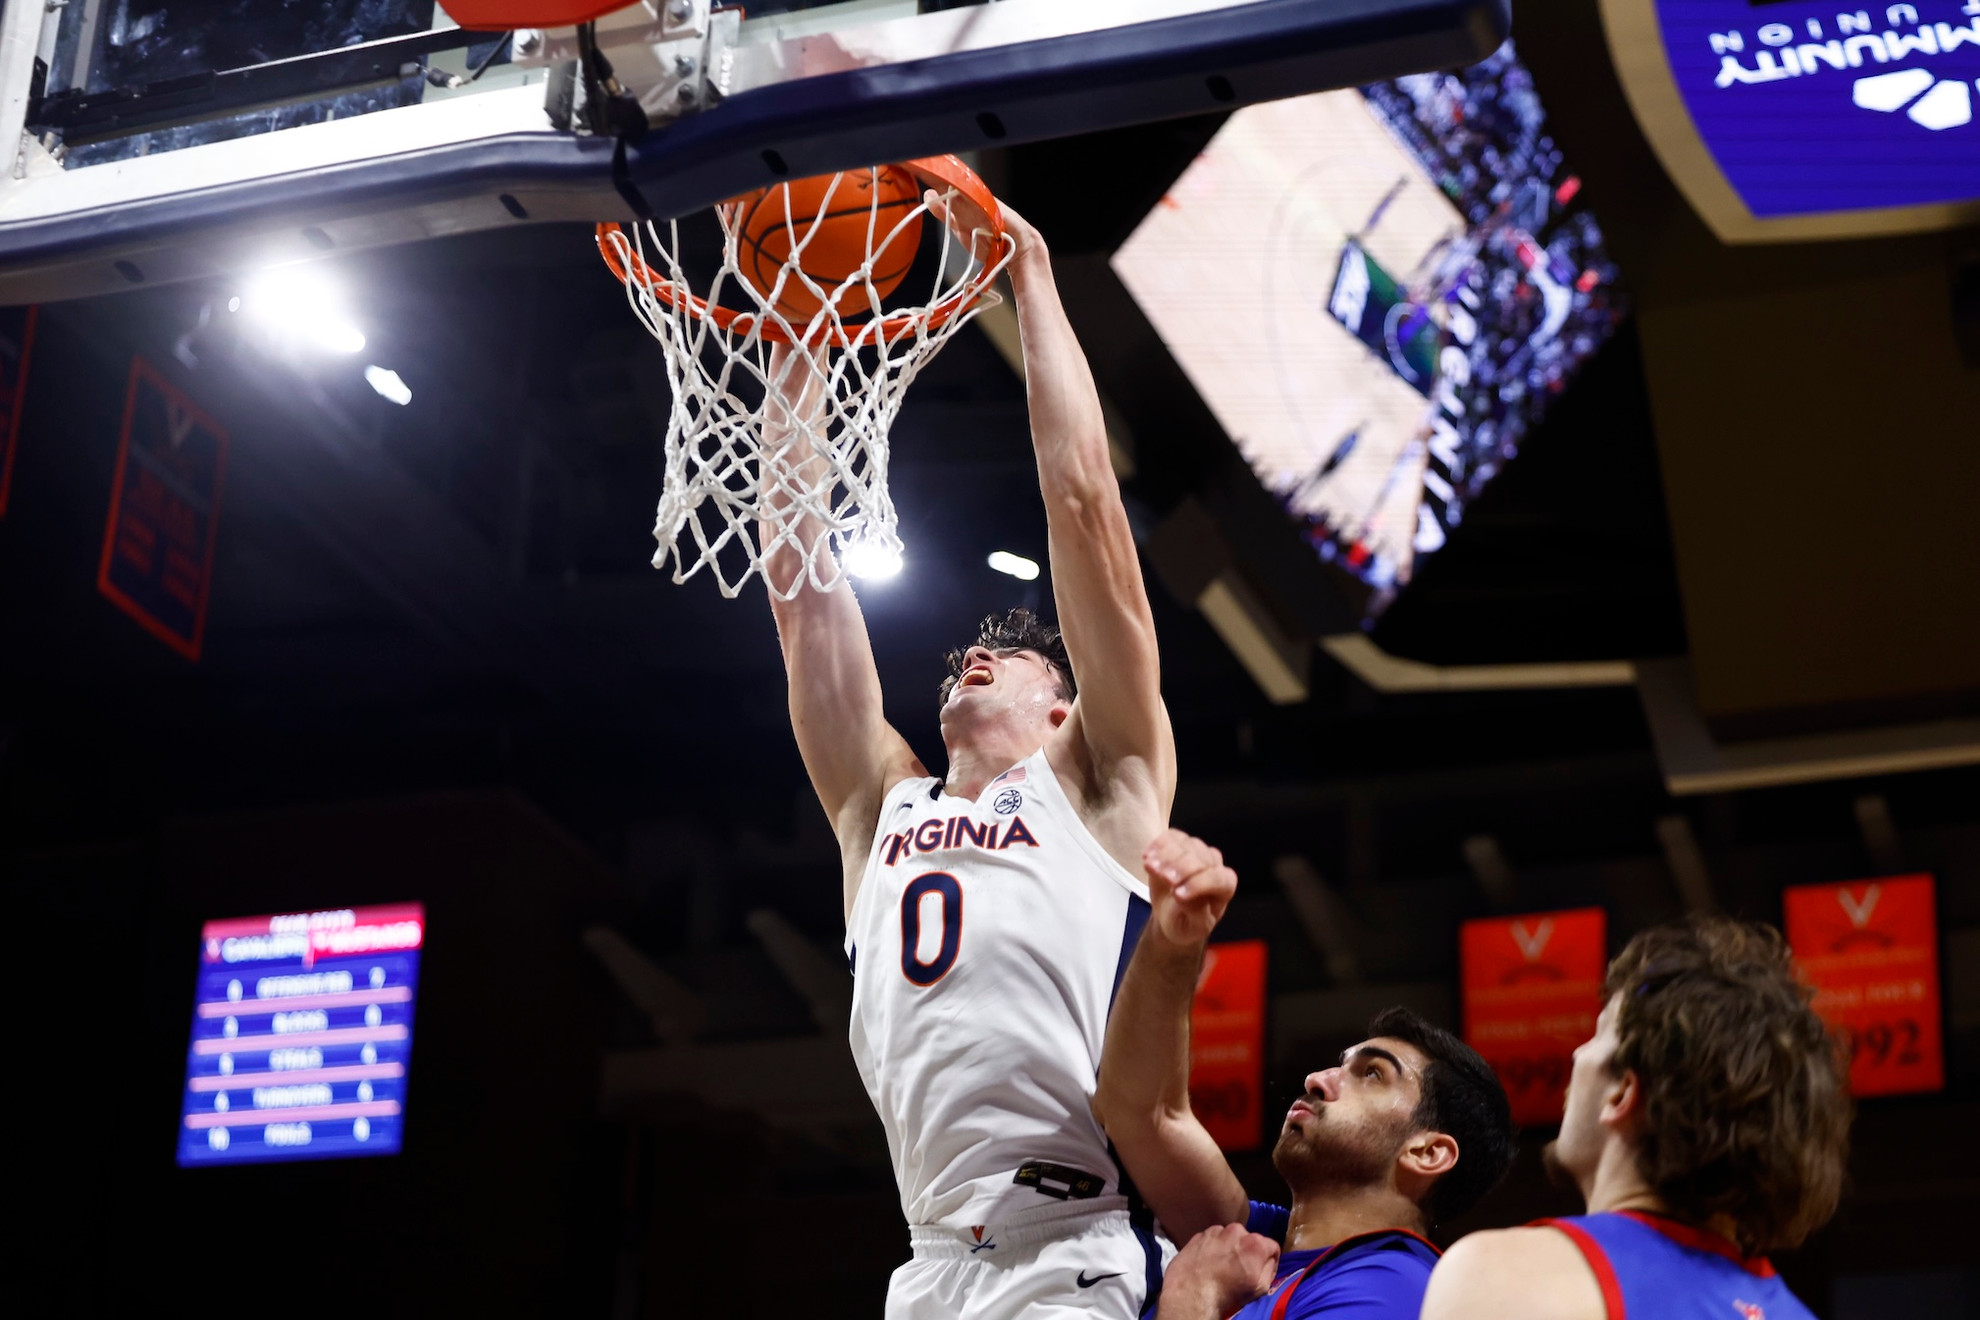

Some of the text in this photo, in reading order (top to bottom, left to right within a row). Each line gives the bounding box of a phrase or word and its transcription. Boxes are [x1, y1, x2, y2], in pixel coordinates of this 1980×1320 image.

[1708, 3, 1919, 54] UNION
[1412, 283, 1480, 553] IRGINIA
[900, 871, 963, 987] 0
[1849, 1018, 1924, 1067] 92
